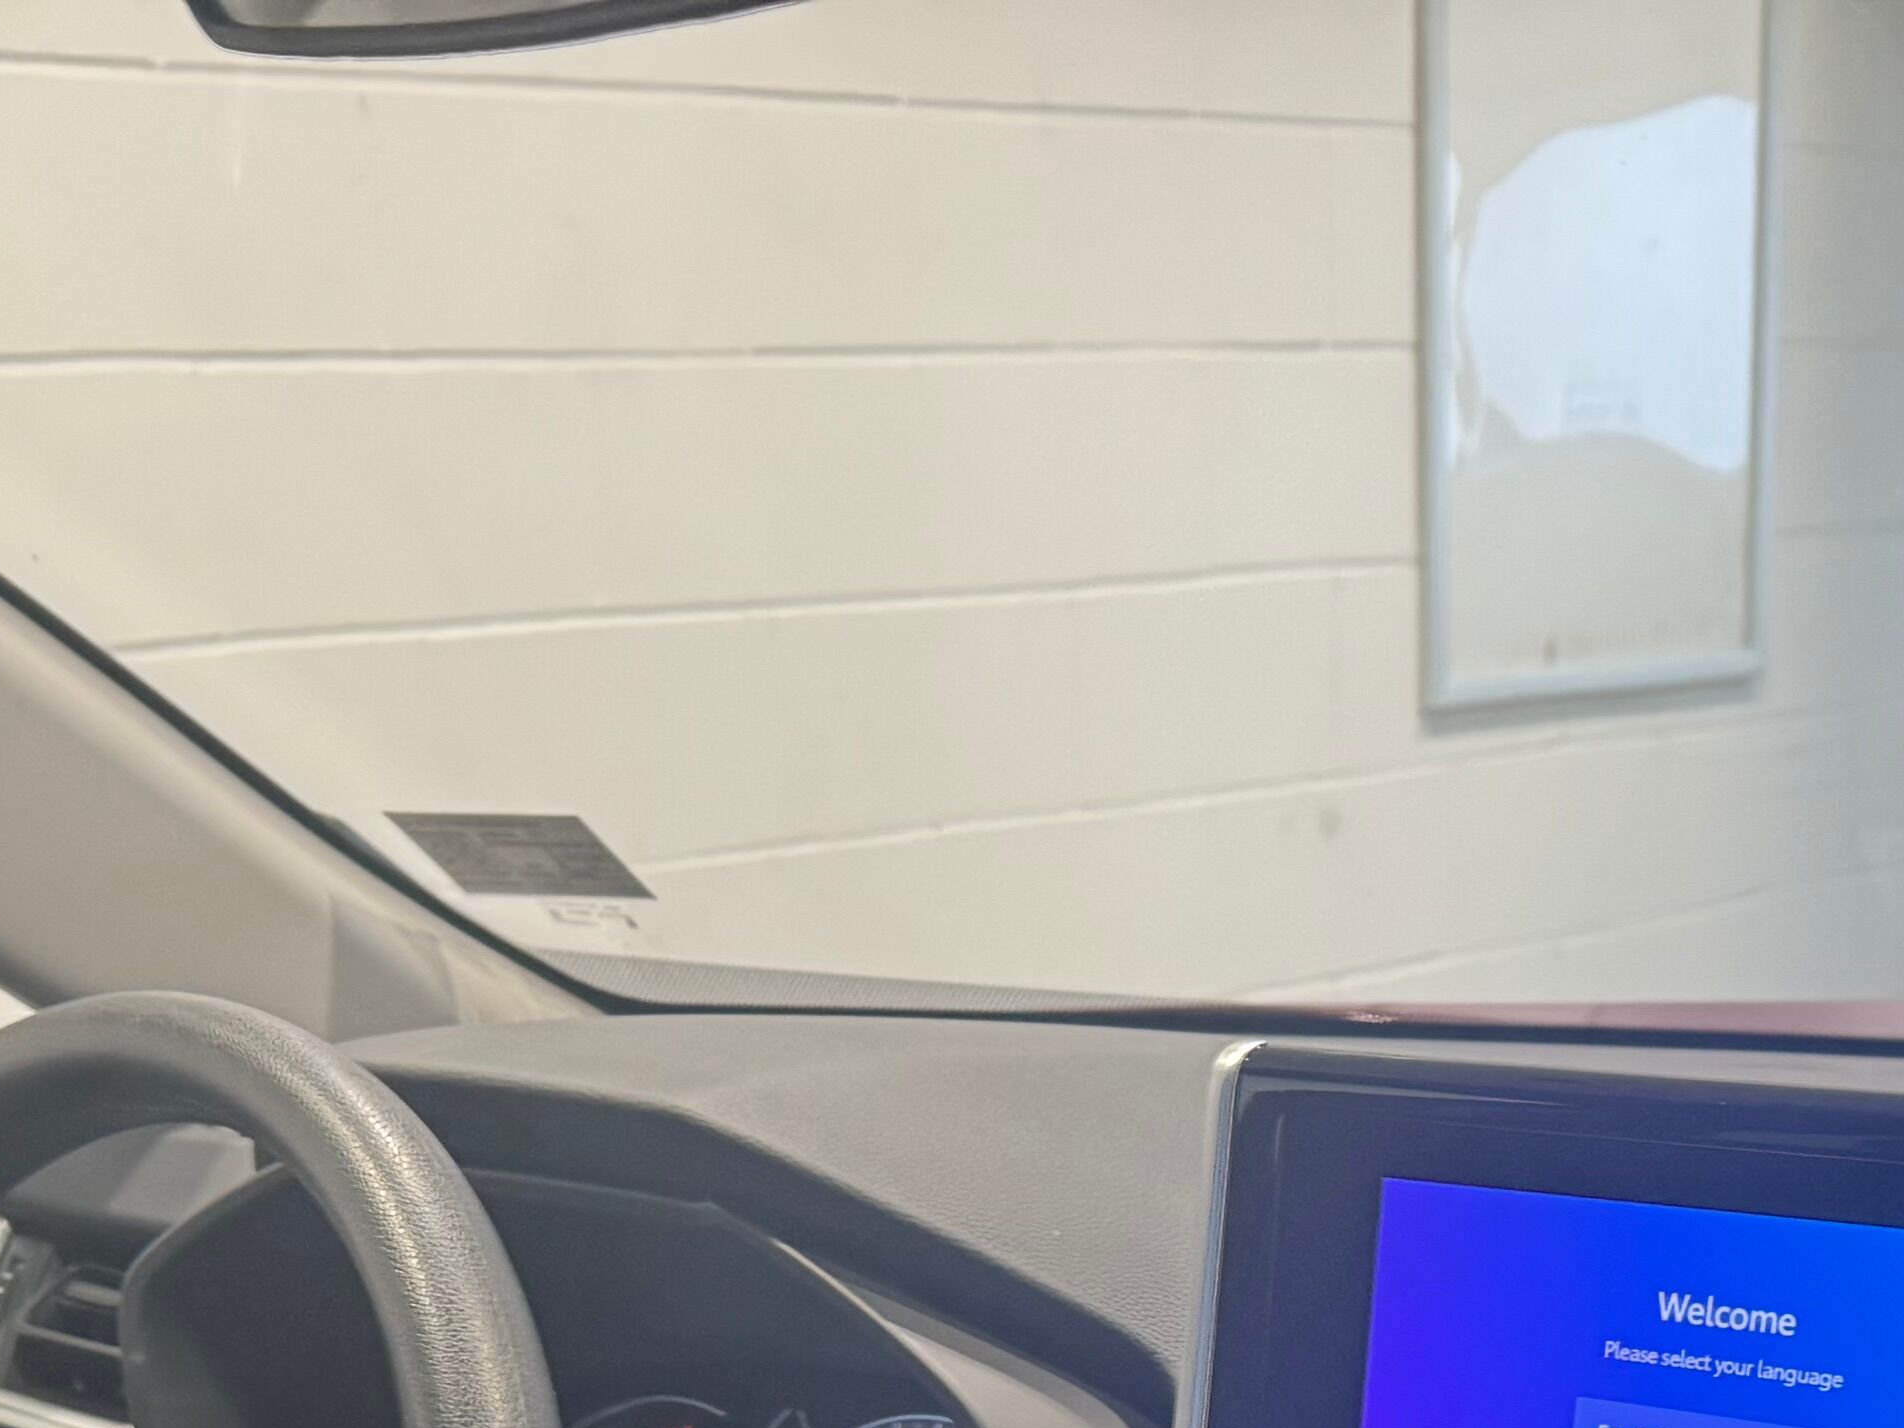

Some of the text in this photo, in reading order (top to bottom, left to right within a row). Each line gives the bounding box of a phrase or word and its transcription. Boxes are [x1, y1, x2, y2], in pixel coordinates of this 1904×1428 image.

[1658, 1291, 1797, 1336] Welcome
[1604, 1340, 1845, 1392] Please select your language
